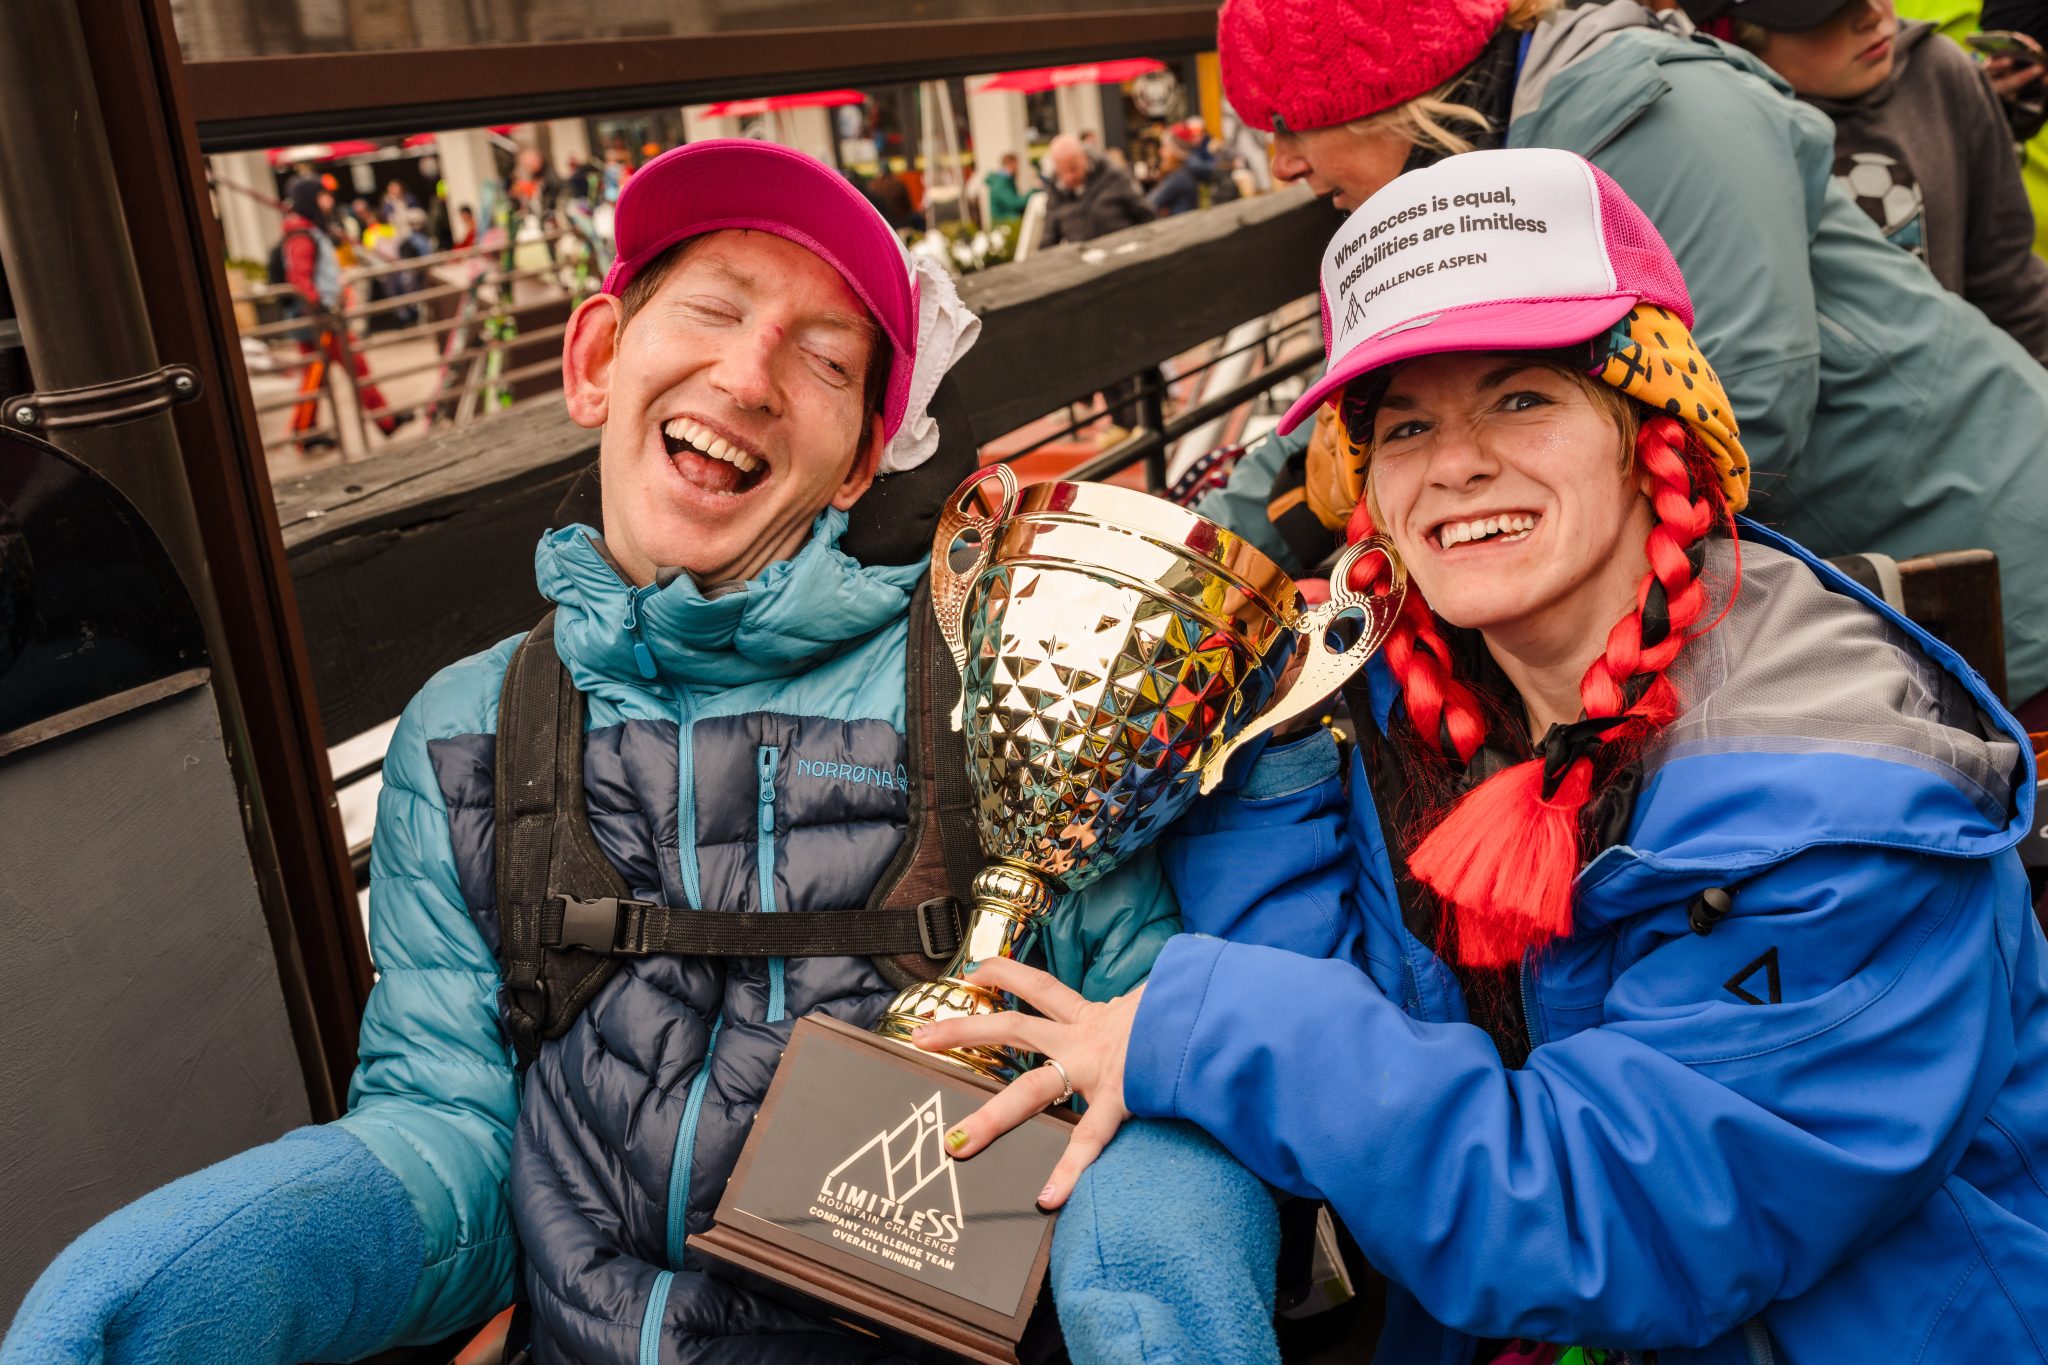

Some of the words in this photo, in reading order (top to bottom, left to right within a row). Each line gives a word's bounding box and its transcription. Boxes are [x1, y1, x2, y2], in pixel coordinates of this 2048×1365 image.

[1334, 233, 1367, 270] When
[1370, 203, 1428, 240] access
[1432, 195, 1449, 213] is
[1453, 186, 1516, 208] equal,
[1340, 233, 1419, 300] possibilities
[1423, 223, 1455, 241] are
[1460, 213, 1547, 234] limitless
[1364, 262, 1435, 304] CHALLENGE
[1438, 252, 1487, 272] ASPEN
[797, 759, 894, 789] NORRØNA
[809, 1206, 861, 1232] COMPANY
[861, 1226, 922, 1258] CHALLENGE
[925, 1251, 955, 1271] TEAM
[817, 1194, 880, 1225] MOUNTAIN
[884, 1220, 956, 1256] CHALLENGE
[820, 1175, 959, 1243] LIMITLESS
[832, 1228, 878, 1254] OVERALL
[881, 1247, 923, 1271] WINNER
